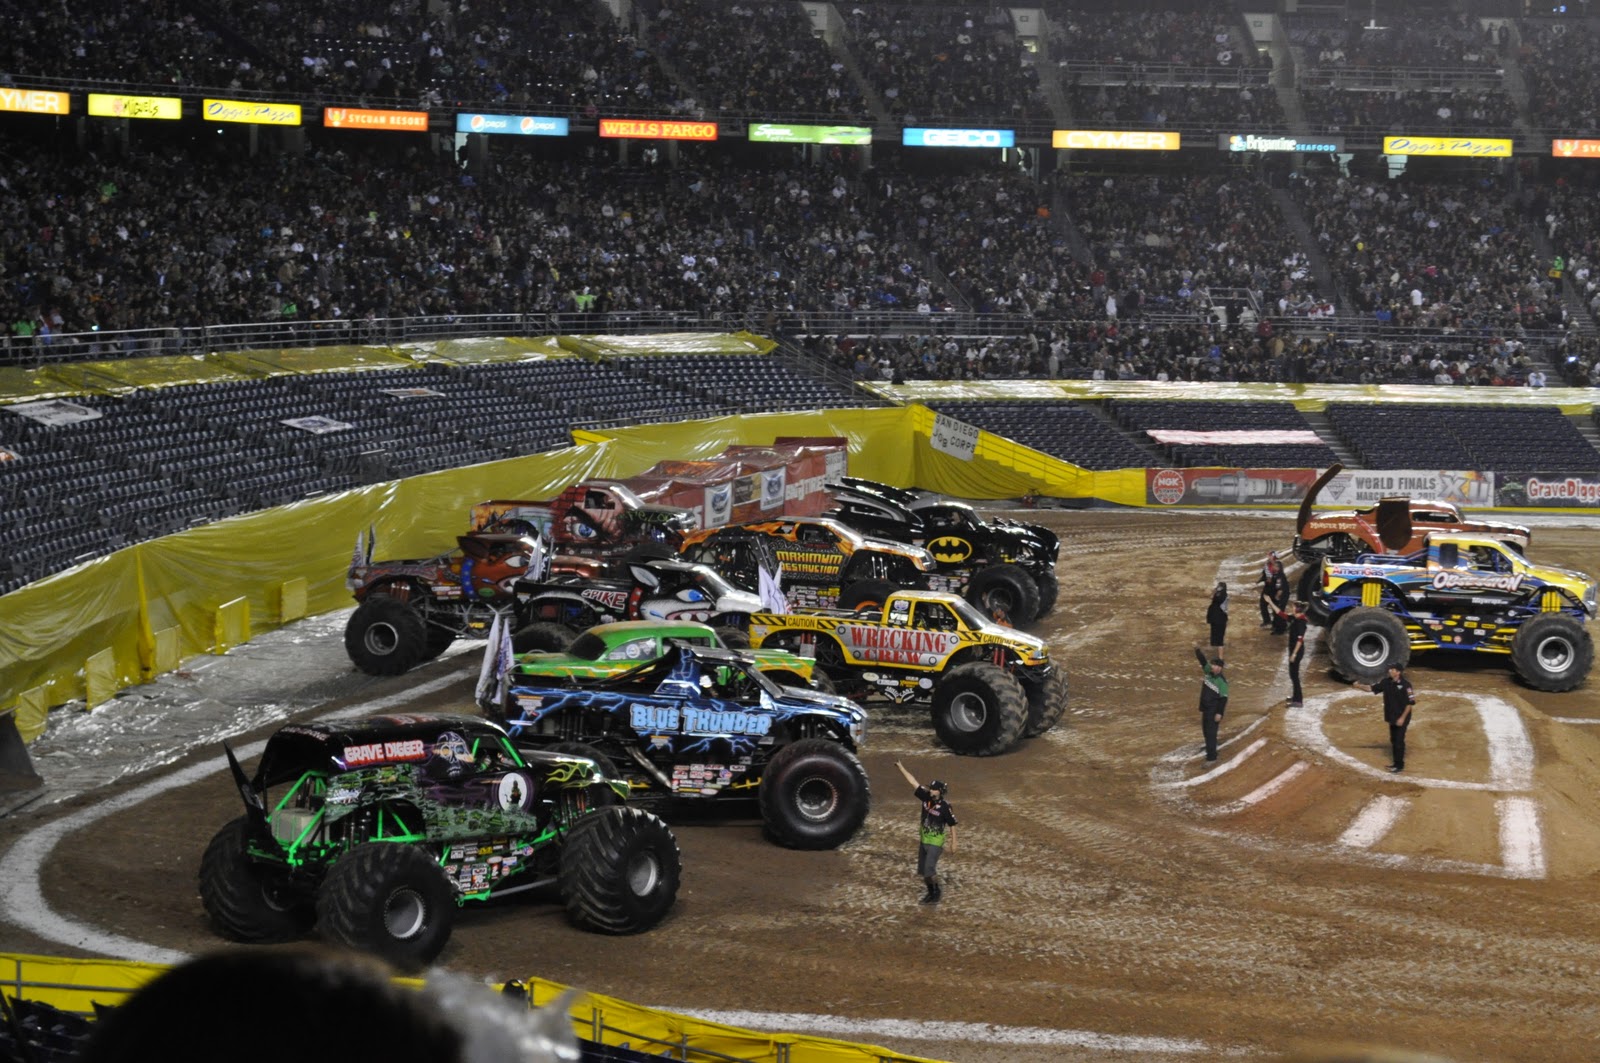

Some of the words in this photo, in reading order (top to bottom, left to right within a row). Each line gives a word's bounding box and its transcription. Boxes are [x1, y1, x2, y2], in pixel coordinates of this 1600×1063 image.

[253, 105, 297, 120] Pizza
[348, 114, 386, 125] SYCUAN
[389, 116, 426, 126] RESORT
[484, 119, 507, 129] pepsi
[532, 121, 556, 131] pepsi
[602, 121, 658, 136] WELLS
[661, 122, 716, 138] FARGO
[922, 128, 1001, 147] GEICO
[1066, 131, 1167, 148] CYMER
[1246, 134, 1297, 153] Brigantine
[1295, 143, 1337, 152] SEAFOOD
[1449, 140, 1508, 153] Pizza
[935, 415, 952, 429] SAN
[953, 422, 978, 439] DIEGO
[932, 429, 948, 447] JOB
[950, 436, 976, 454] CORPS
[1157, 477, 1180, 487] NGK
[1355, 476, 1394, 490] WORLD
[1398, 477, 1437, 490] FINALS
[776, 550, 844, 565] MAXIMUM
[1332, 567, 1386, 577] AmeriGas
[581, 588, 628, 610] SPIKE
[787, 617, 816, 628] CAUTION
[850, 626, 947, 654] WRECKING
[863, 649, 924, 664] CREW
[630, 703, 680, 730] BLUE
[680, 707, 772, 736] THUNDER
[343, 744, 384, 764] GRAVE
[384, 740, 426, 760] DIGGER
